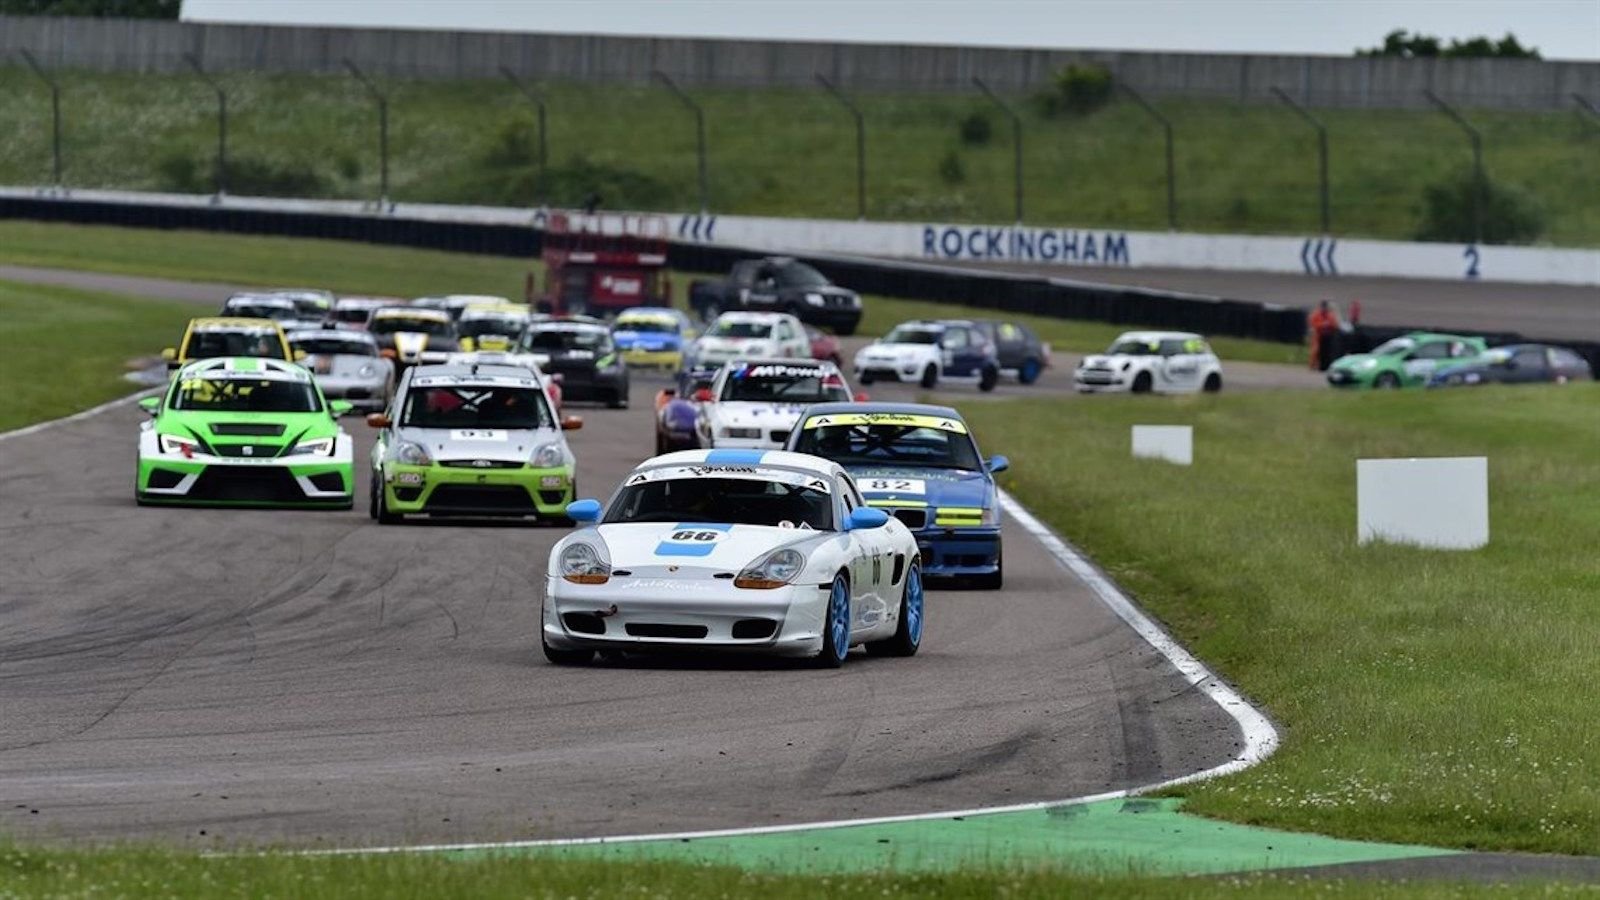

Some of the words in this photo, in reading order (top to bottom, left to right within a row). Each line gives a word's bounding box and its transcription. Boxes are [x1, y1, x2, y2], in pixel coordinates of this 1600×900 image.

[922, 226, 1130, 263] ROCKINGHAM
[1464, 247, 1480, 276] 2
[817, 417, 831, 425] A
[941, 420, 955, 429] A
[631, 474, 647, 484] A
[809, 480, 826, 490] A
[871, 479, 911, 492] 82
[672, 530, 718, 541] 66
